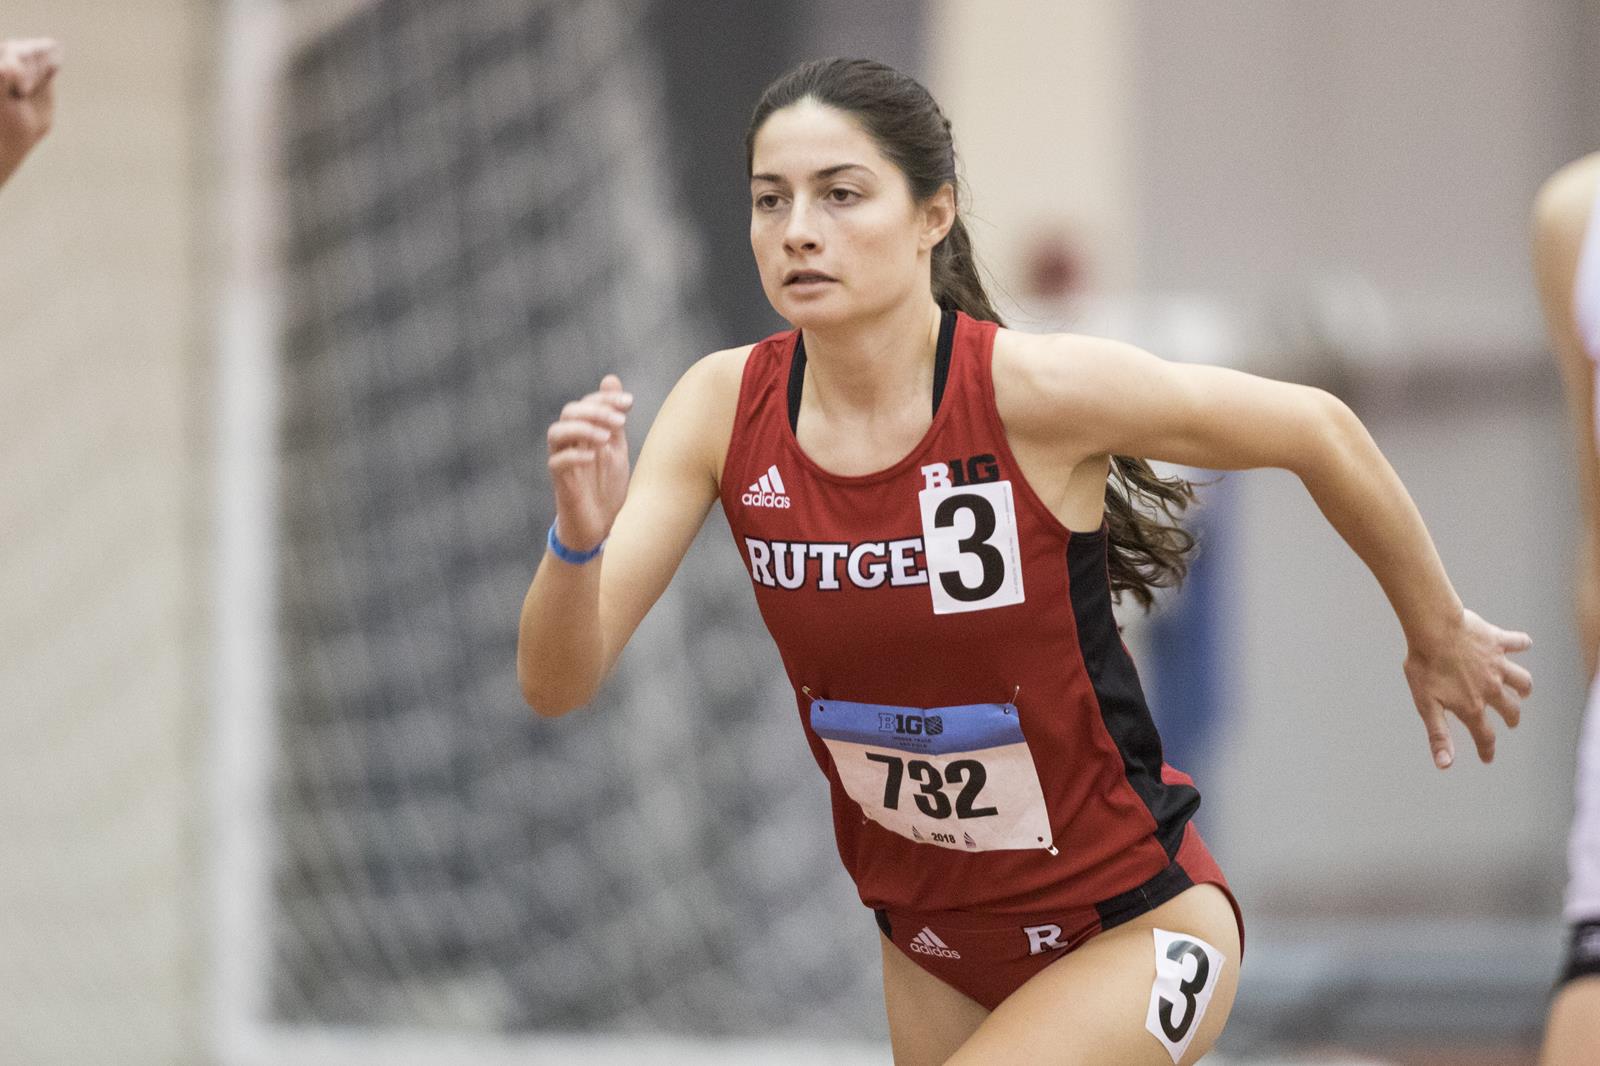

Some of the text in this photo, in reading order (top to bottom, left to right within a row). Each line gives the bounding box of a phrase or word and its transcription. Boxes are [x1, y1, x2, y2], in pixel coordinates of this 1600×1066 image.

[741, 491, 791, 509] adidas
[934, 493, 1005, 602] 3
[865, 751, 999, 820] 732
[931, 832, 956, 844] 2018
[910, 942, 961, 959] adidas
[1023, 923, 1069, 956] R
[1158, 939, 1210, 1043] 3
